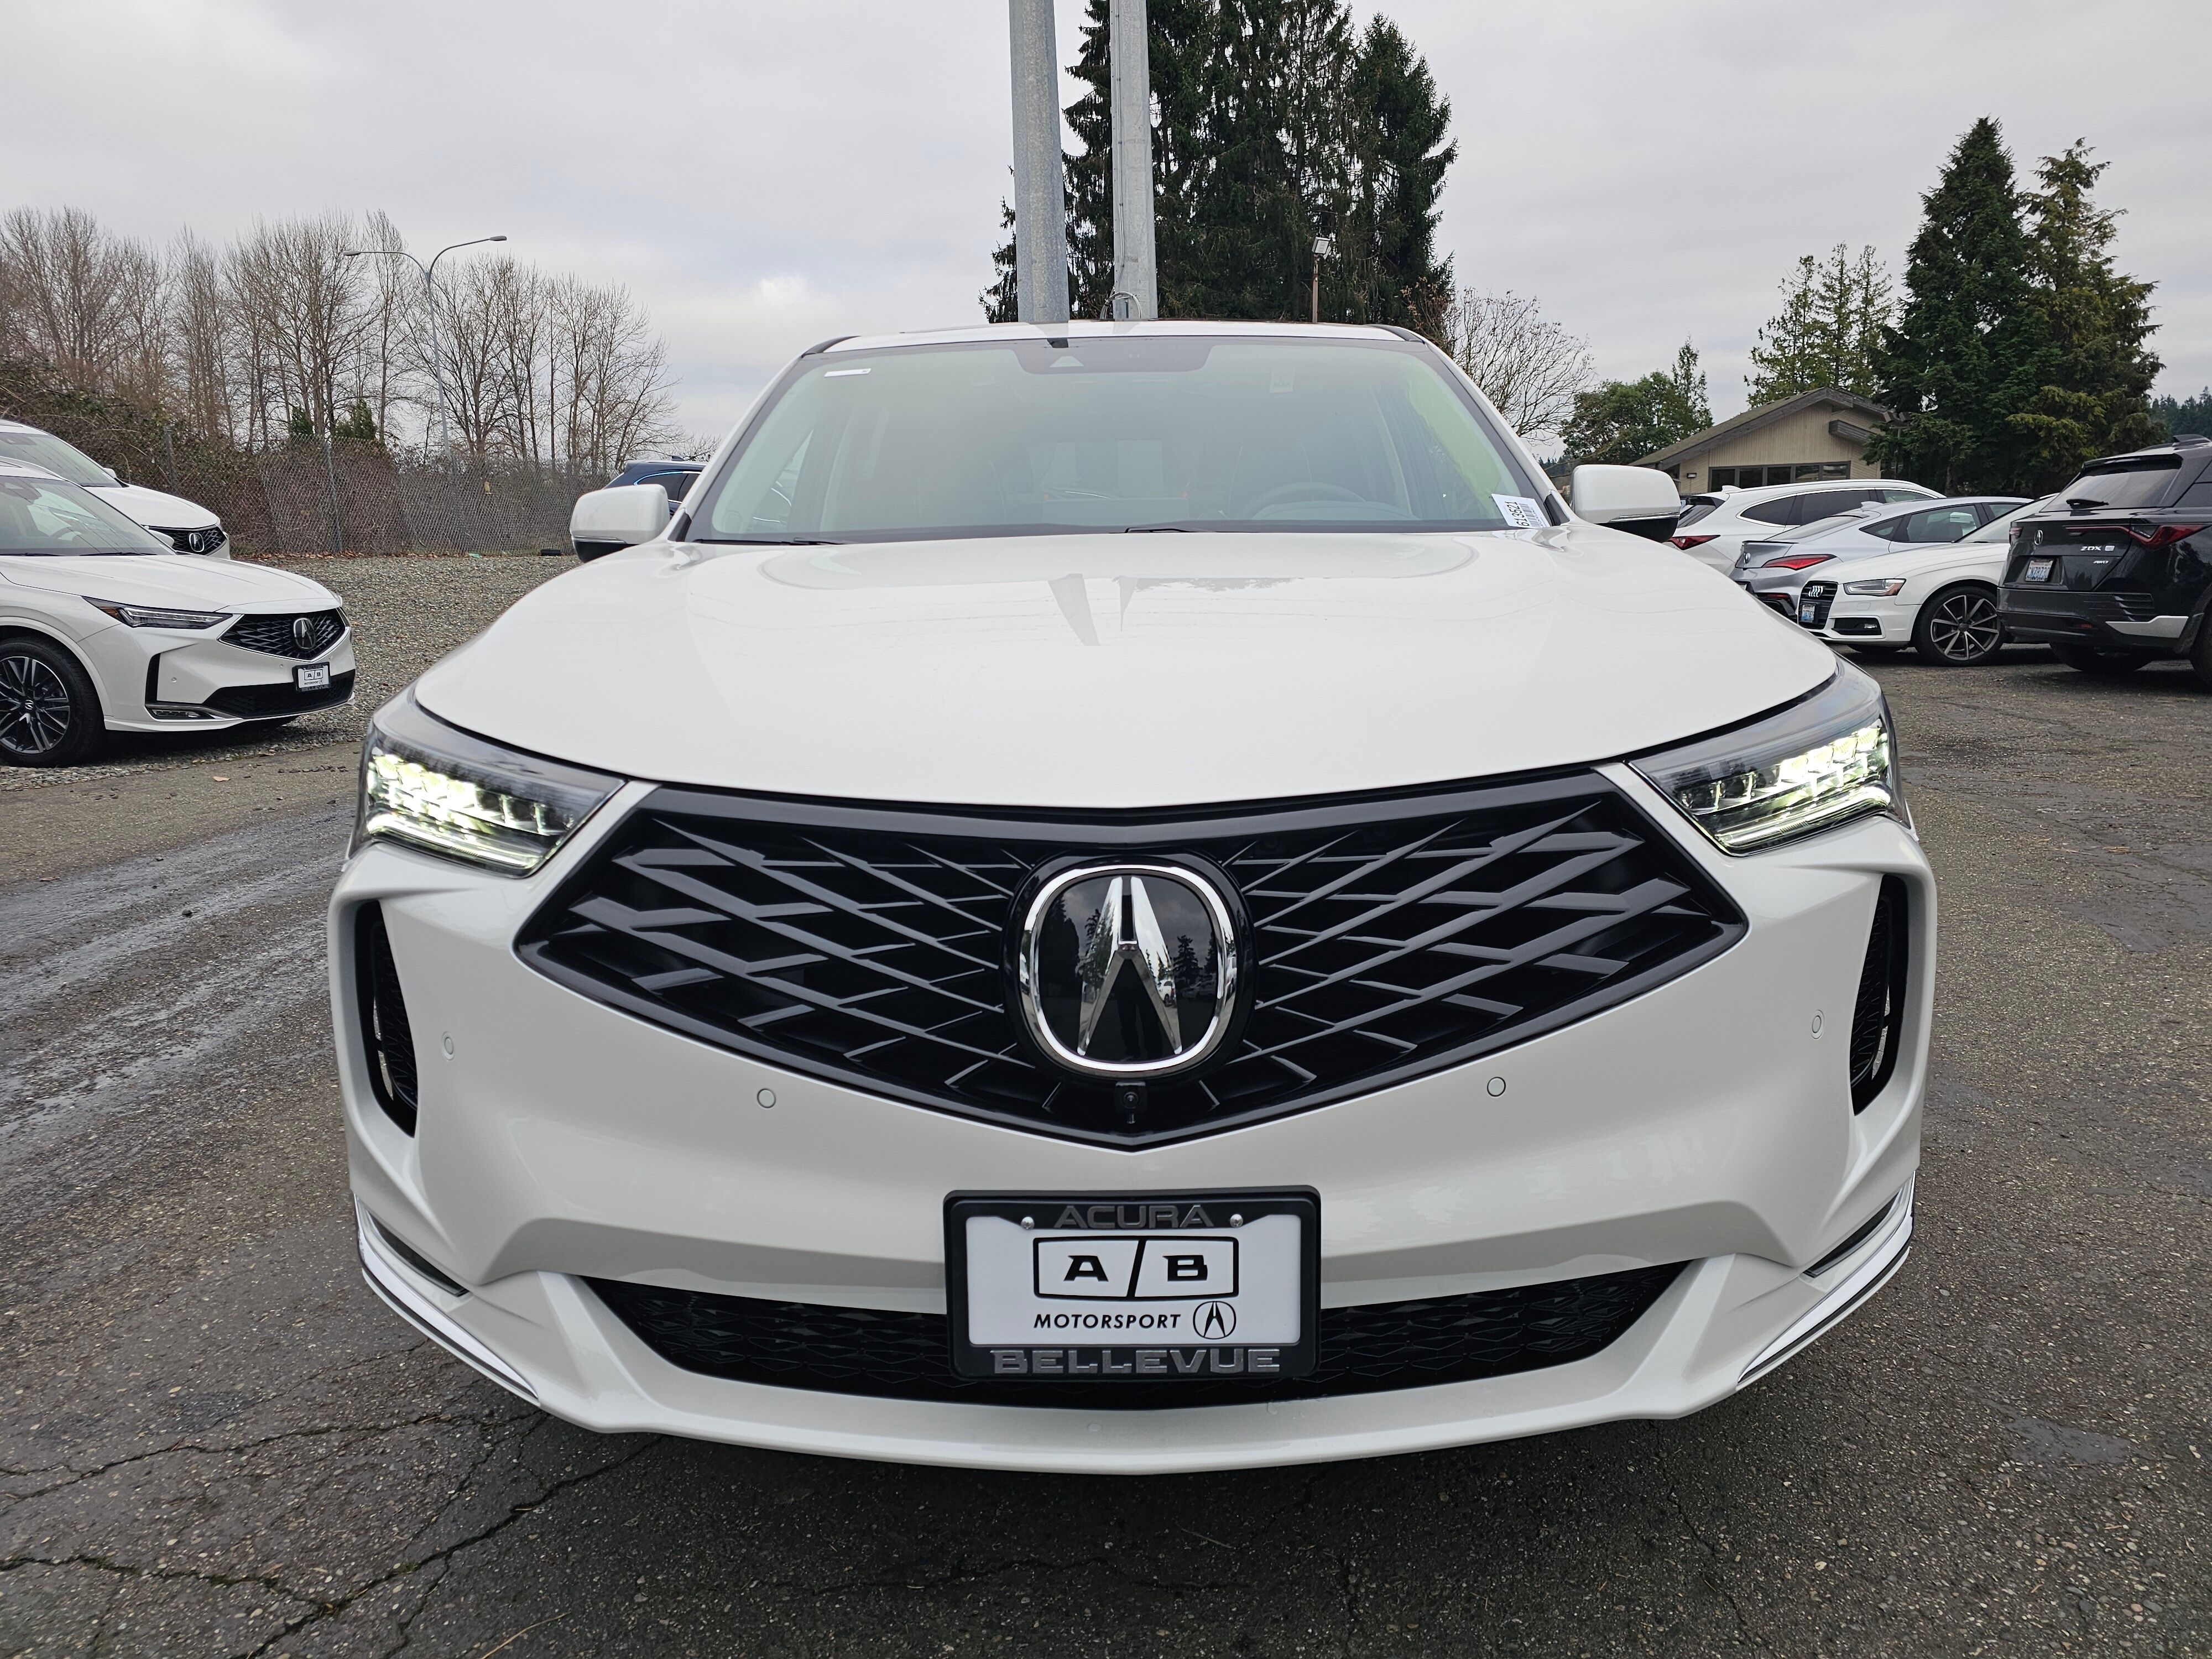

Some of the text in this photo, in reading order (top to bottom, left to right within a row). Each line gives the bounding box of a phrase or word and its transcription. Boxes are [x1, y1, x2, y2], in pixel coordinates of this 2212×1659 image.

[1505, 502, 1530, 526] 613521
[1053, 1204, 1214, 1229] ACURA
[1063, 1255, 1208, 1282] A B
[1033, 1313, 1182, 1329] MOTORSPORT
[989, 1348, 1281, 1375] BELLEVUE
